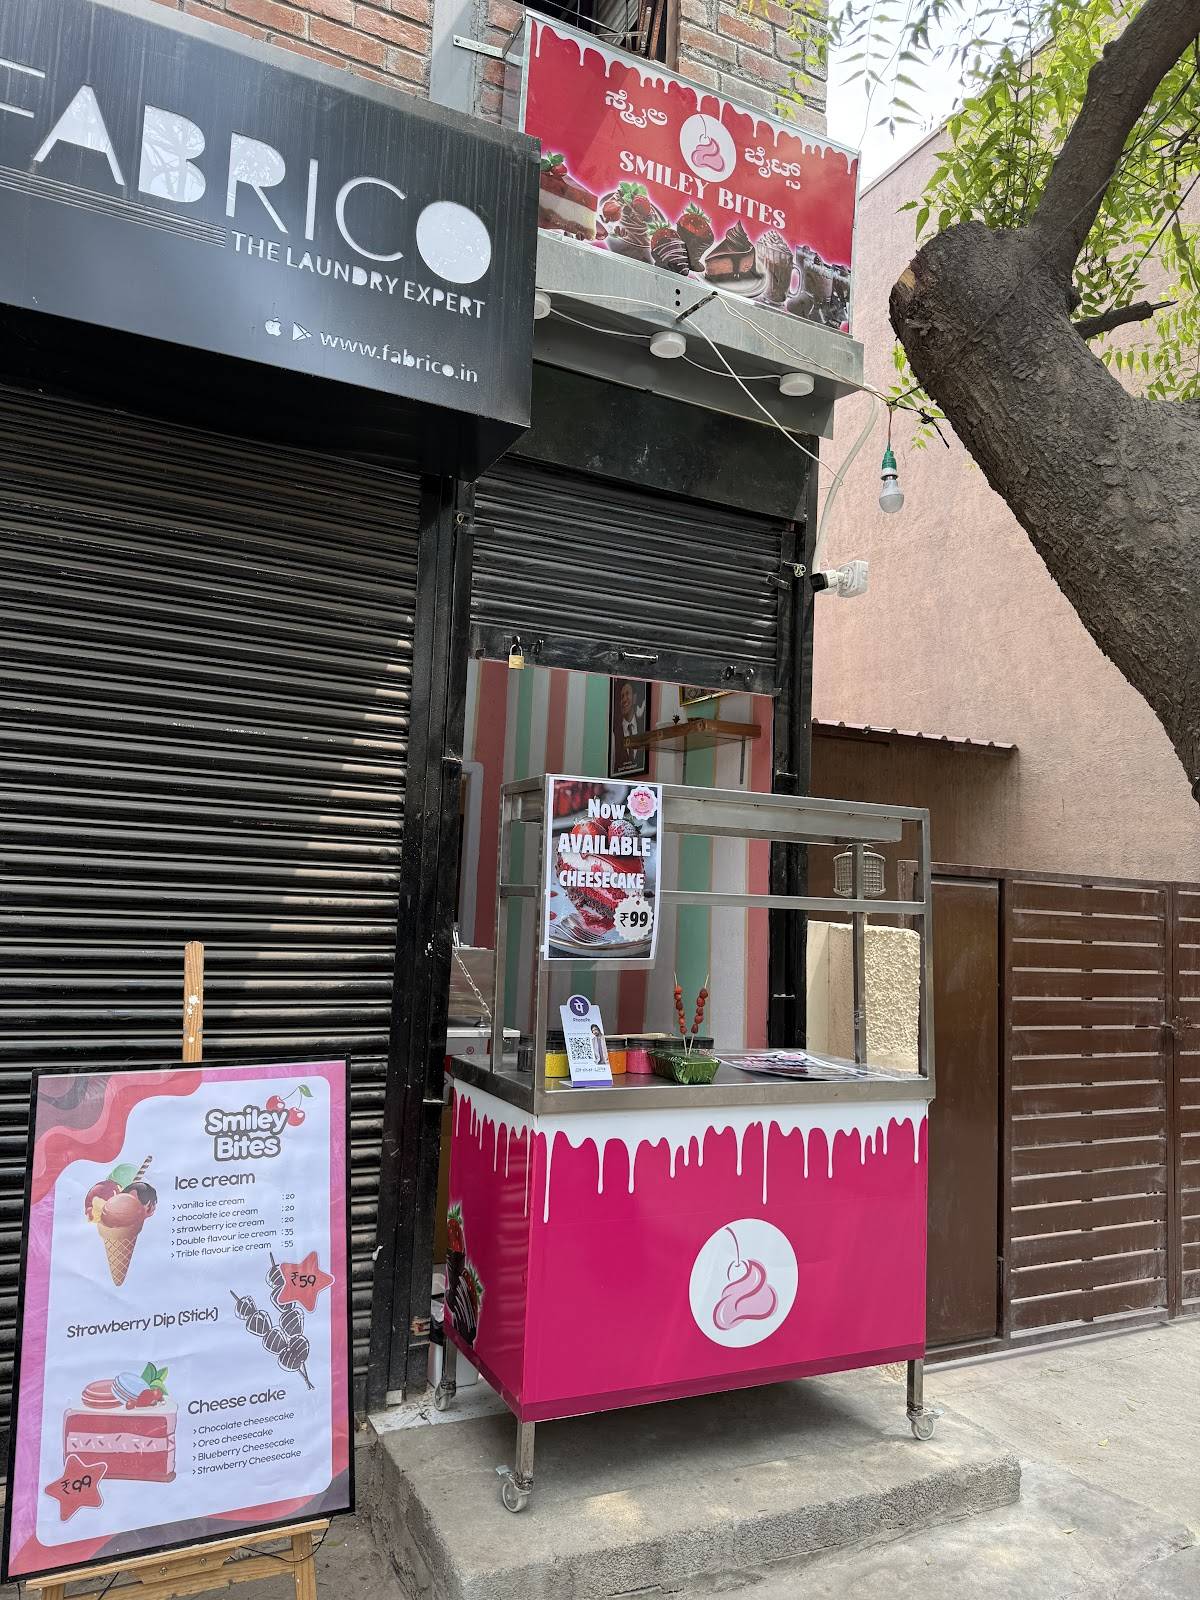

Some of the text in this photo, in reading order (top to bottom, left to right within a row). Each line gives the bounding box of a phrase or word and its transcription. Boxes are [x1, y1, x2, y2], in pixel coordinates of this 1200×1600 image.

[619, 150, 786, 229] SMILEY BITES
[232, 230, 485, 318] THE LAUNDRY EXPERT
[319, 332, 478, 383] www.fabrico.in
[557, 833, 651, 857] AVAILABLE
[559, 870, 645, 889] CHEESECAKE
[619, 911, 648, 927] ₹99
[206, 1106, 288, 1135] Smiley
[214, 1134, 281, 1161] Bites
[175, 1172, 255, 1190] Ice cream
[177, 1198, 245, 1210] vanilla ice cream
[176, 1208, 259, 1222] chocolate ice cream
[176, 1219, 265, 1234] strawberry ice cream
[176, 1229, 277, 1246] Double flavour ice cream
[176, 1242, 272, 1258] Trible flavour ice cream
[290, 1272, 317, 1288] ₹59
[66, 1306, 219, 1338] Strawberry Dip (Stick)
[187, 1388, 286, 1415] Cheese cake
[198, 1412, 295, 1434] Chocolate cheesecake
[197, 1428, 273, 1448] Oreo cheesecake
[197, 1438, 295, 1461] Blueberry Cheesecake
[197, 1450, 302, 1475] Strawberry Cheesecake
[61, 1474, 92, 1495] ₹99
